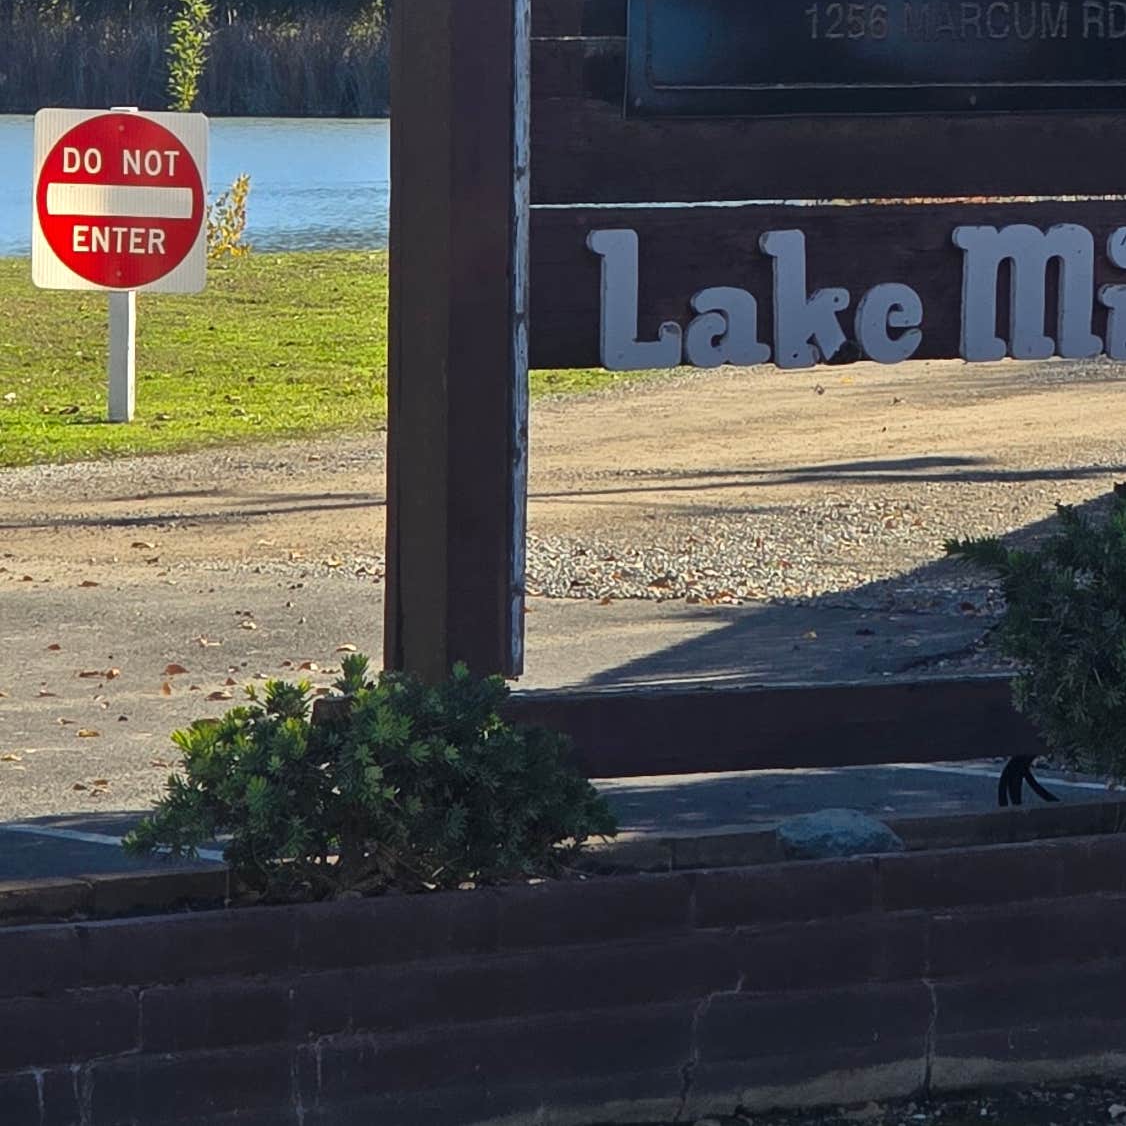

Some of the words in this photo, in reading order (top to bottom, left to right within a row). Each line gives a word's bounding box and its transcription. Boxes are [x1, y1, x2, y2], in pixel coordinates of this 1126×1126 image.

[805, 2, 889, 41] 1256
[902, 0, 1069, 41] MARCUM
[63, 147, 102, 174] DO
[122, 149, 180, 176] NOT
[72, 225, 166, 255] ENTER
[586, 228, 923, 371] Lake
